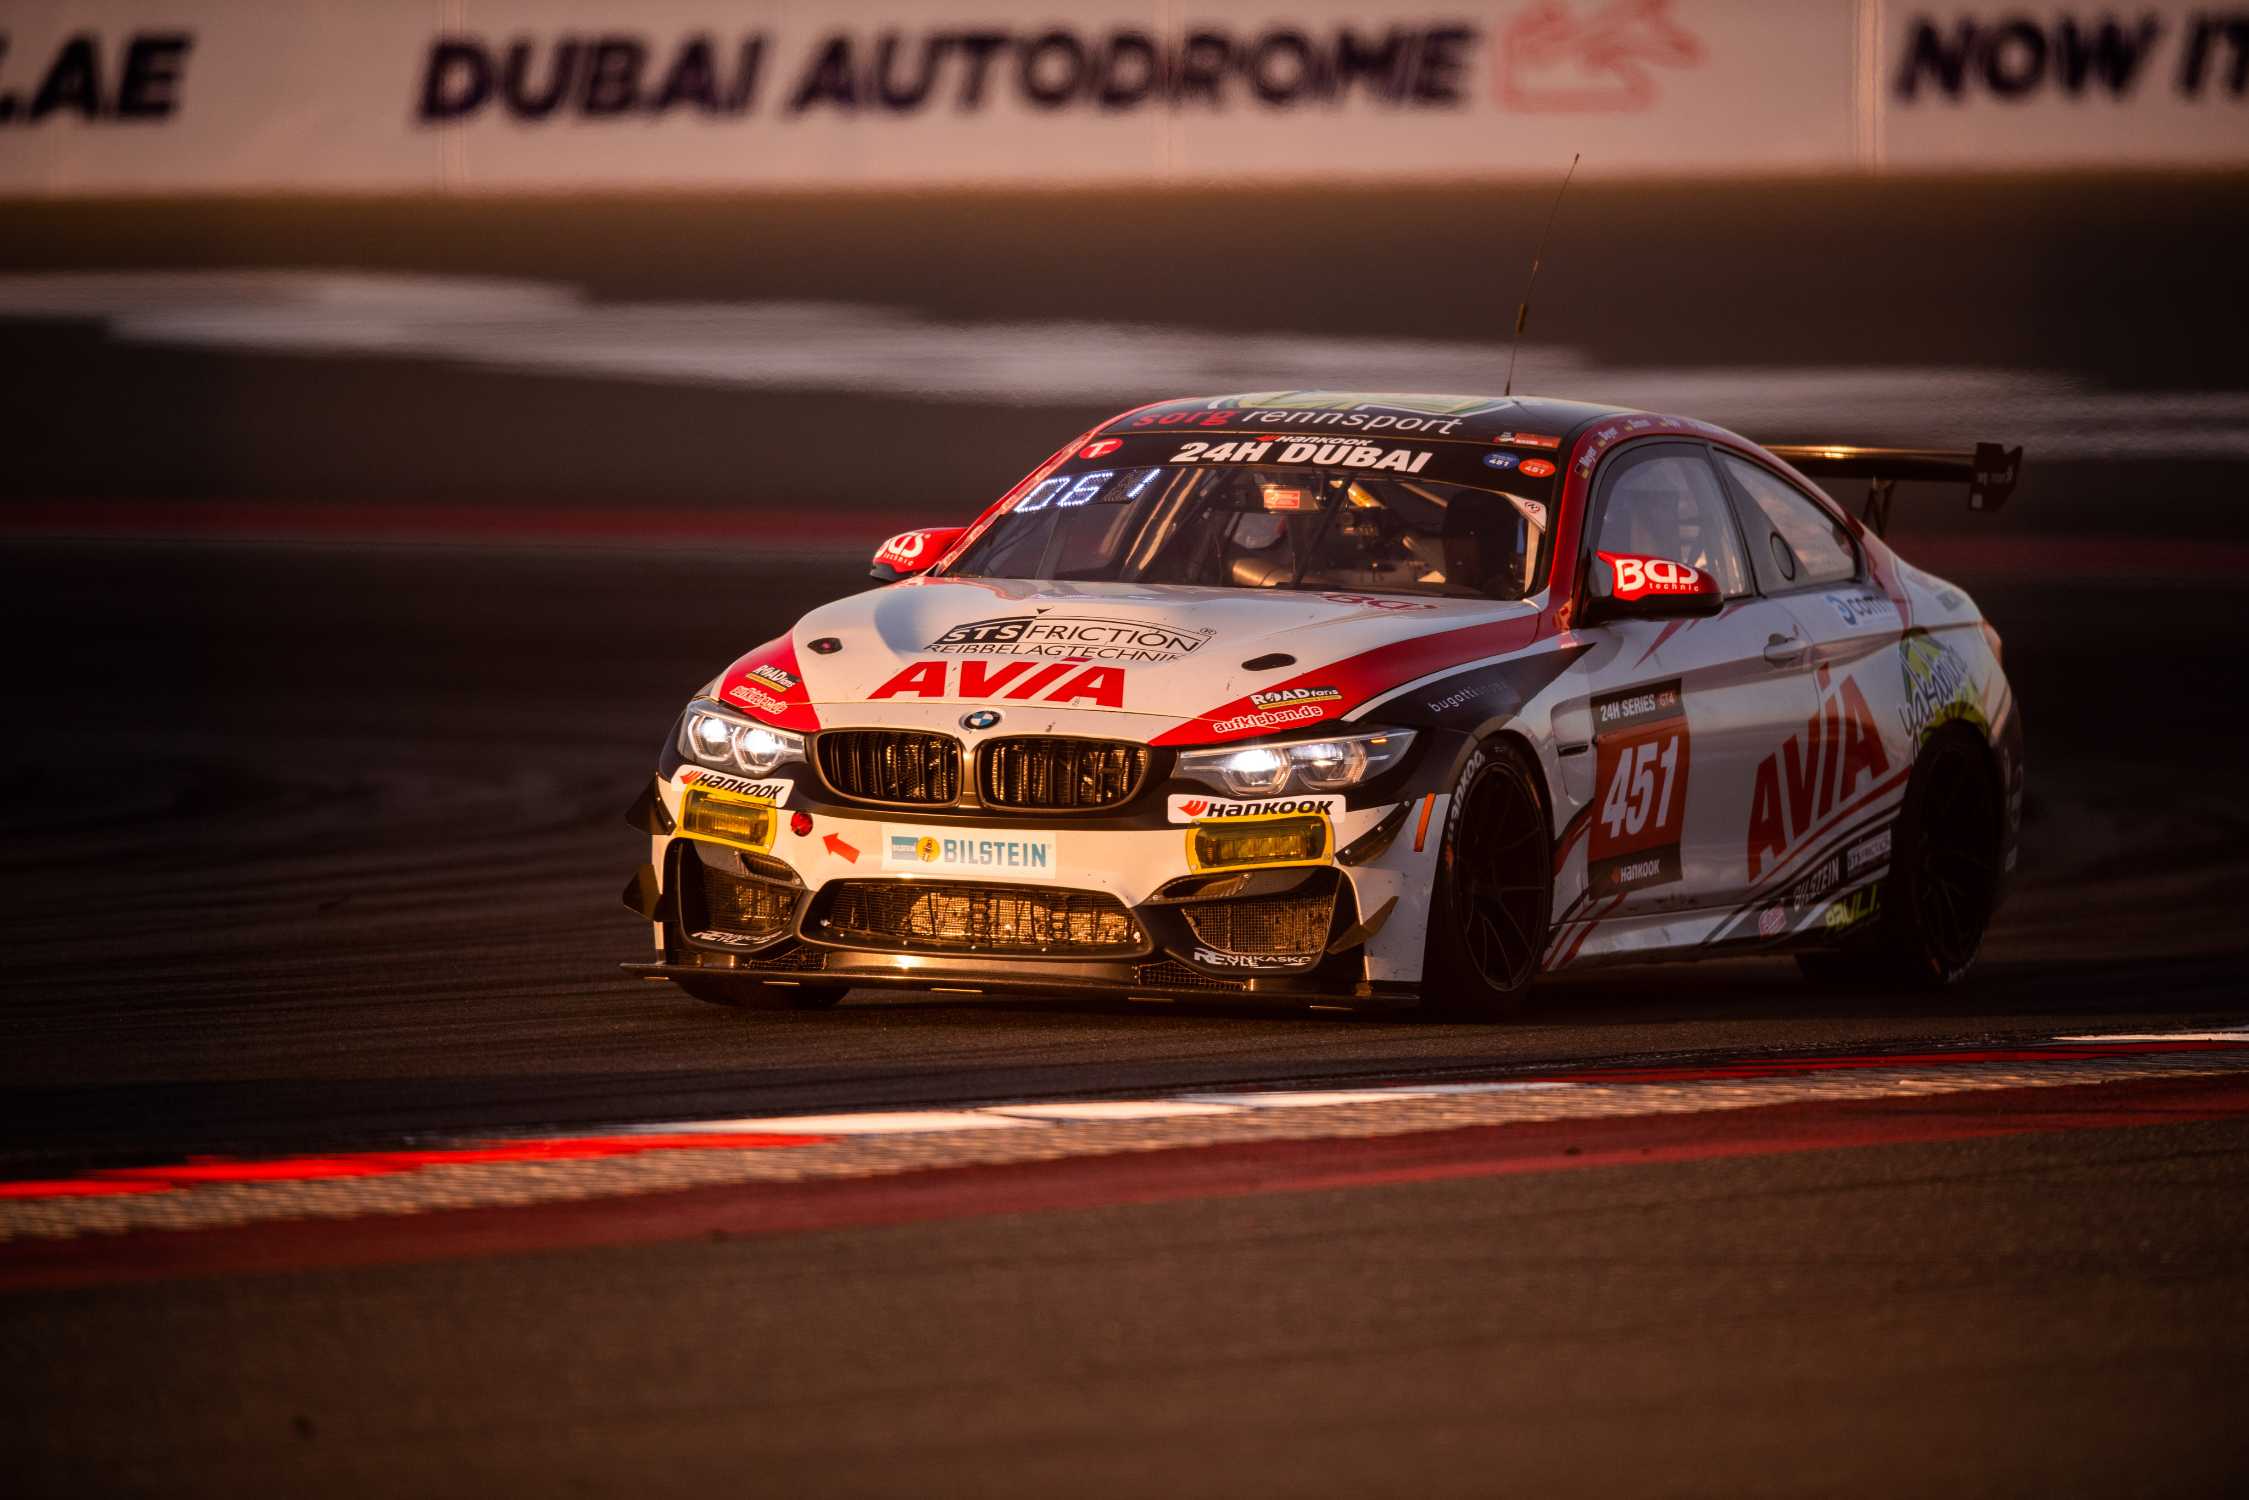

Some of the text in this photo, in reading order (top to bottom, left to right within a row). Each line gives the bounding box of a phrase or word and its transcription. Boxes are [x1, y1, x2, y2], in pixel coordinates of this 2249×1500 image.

[1893, 10, 2164, 103] NOW
[0, 32, 195, 122] .AE
[415, 24, 1484, 124] DUBAI AUTODROME
[1132, 409, 1464, 435] sorg rennsport
[1169, 442, 1434, 473] 24H DUBAI
[1648, 582, 1700, 593] technic
[944, 623, 1205, 652] STS FRICTION
[1250, 688, 1310, 706] ROAD
[1600, 701, 1621, 722] 24H
[1621, 694, 1656, 717] SERIES
[1213, 704, 1324, 733] aufkleben.de
[1600, 735, 1679, 839] 451
[943, 838, 1047, 868] BILSTEIN
